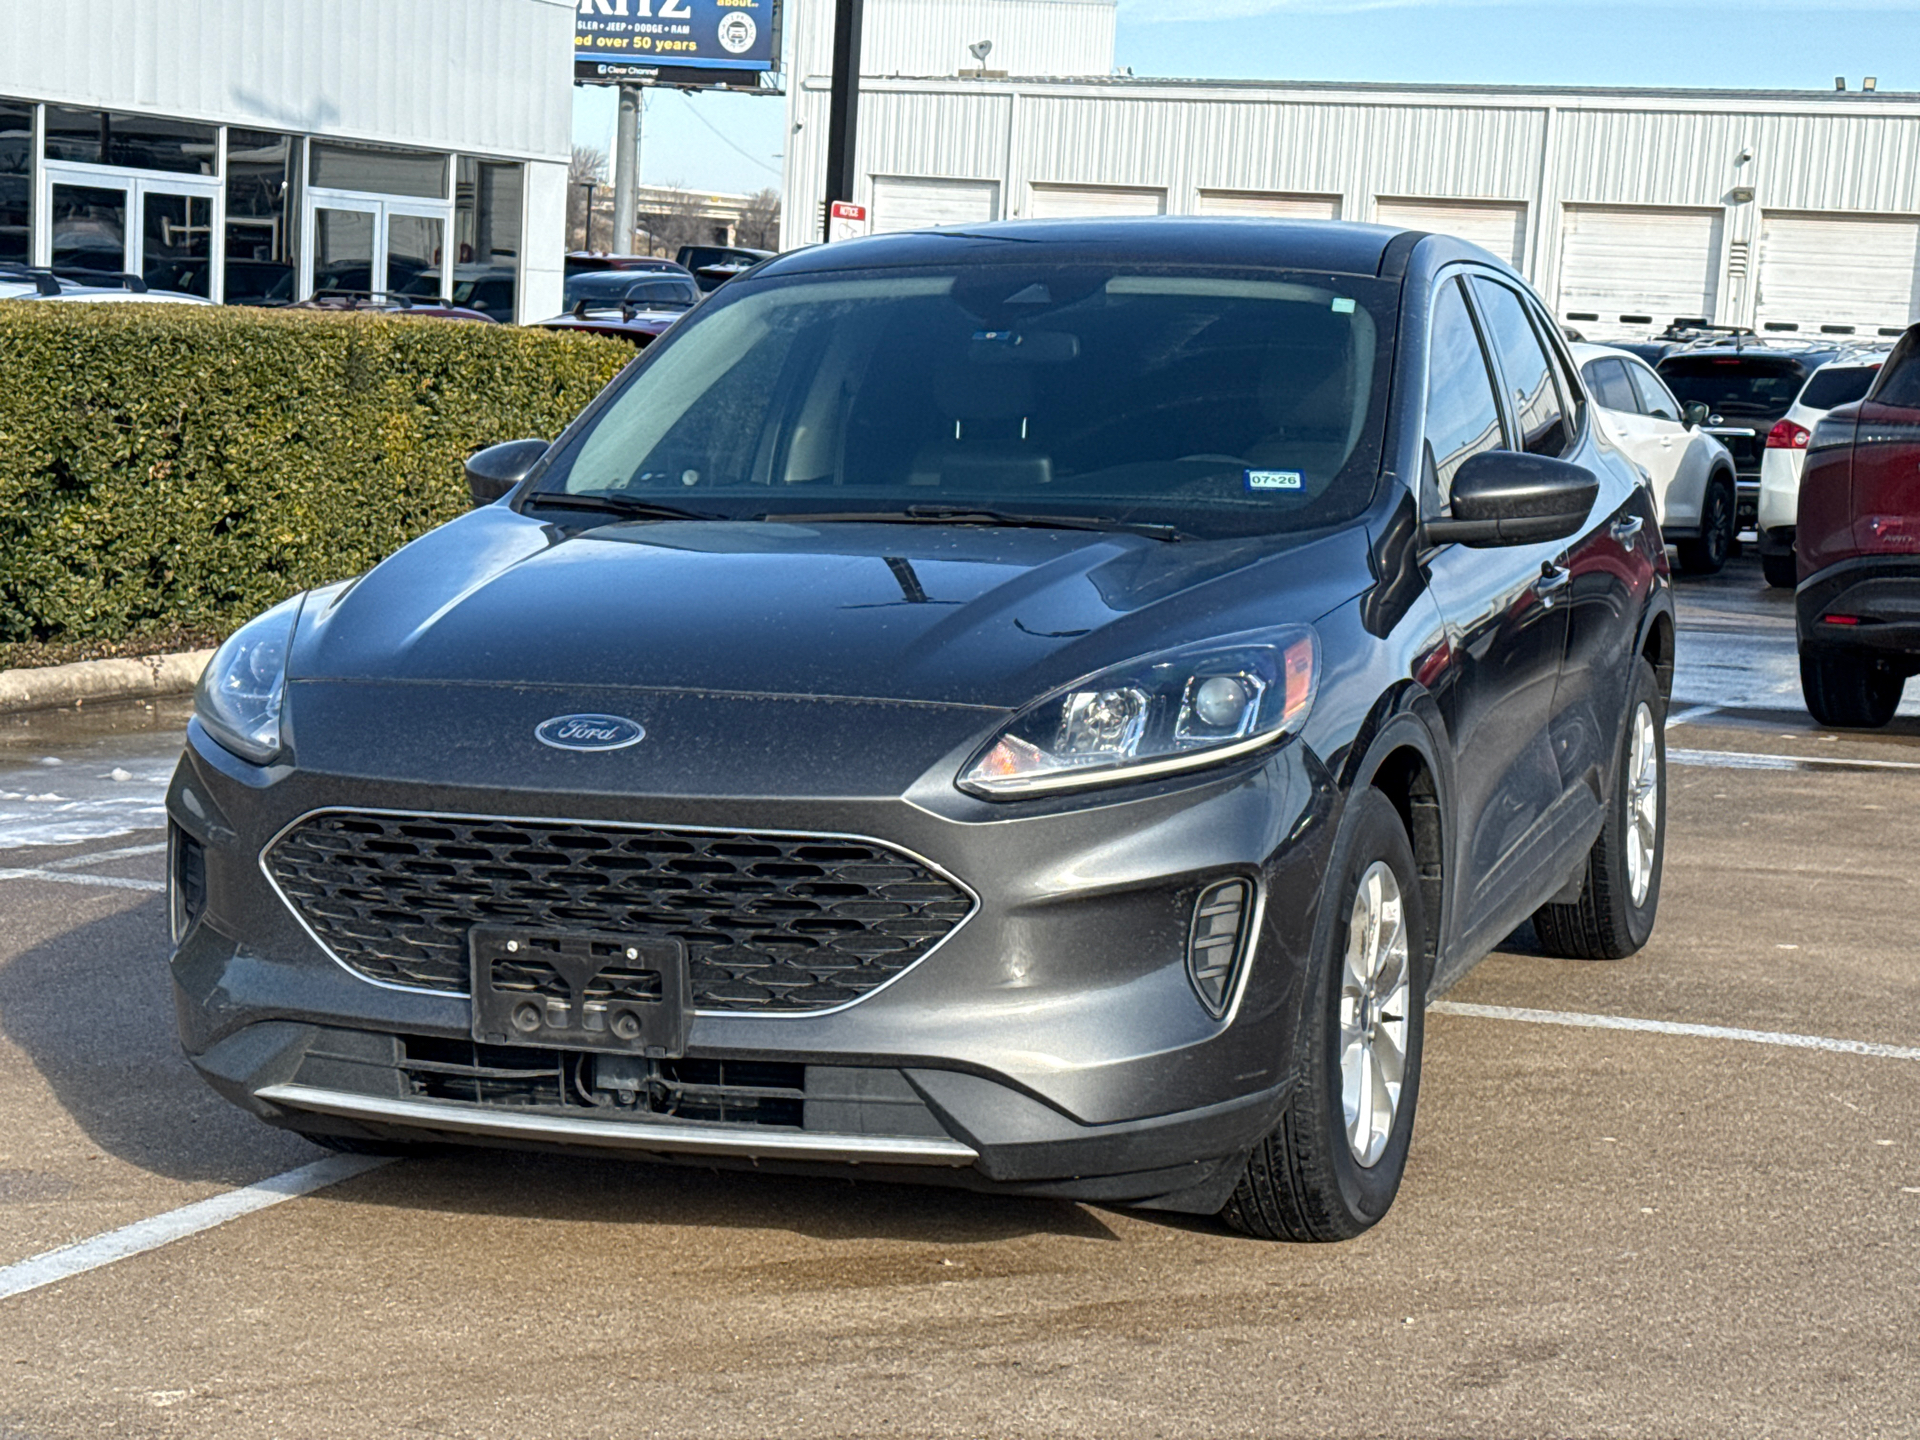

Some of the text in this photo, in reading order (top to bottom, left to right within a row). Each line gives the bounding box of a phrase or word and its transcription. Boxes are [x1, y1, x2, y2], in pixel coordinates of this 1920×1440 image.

[571, 0, 691, 18] RITZ
[577, 20, 690, 34] SLER JEEP DODGE RAM
[574, 34, 697, 52] ed over 50 years
[607, 65, 659, 75] Clear Channel
[557, 720, 620, 740] Ford
